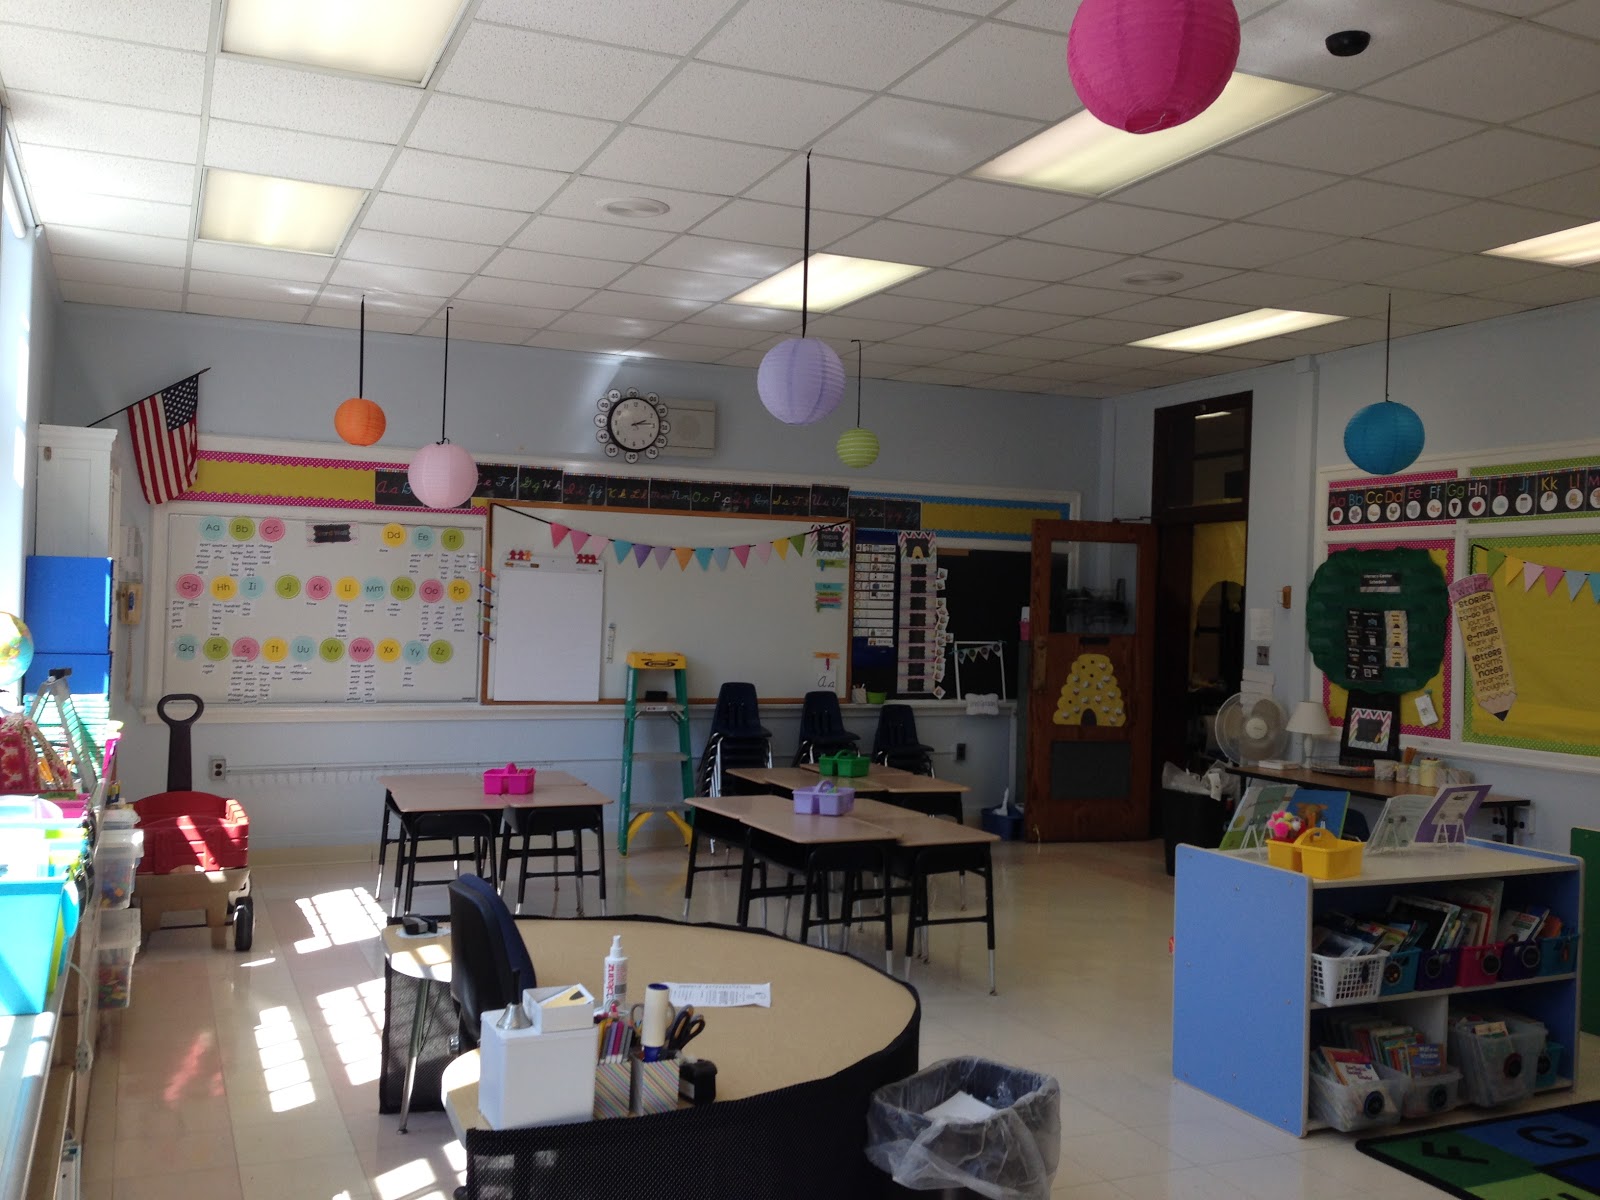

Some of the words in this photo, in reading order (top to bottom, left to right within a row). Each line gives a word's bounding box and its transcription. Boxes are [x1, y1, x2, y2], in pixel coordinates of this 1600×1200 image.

[1519, 476, 1530, 493] Jj
[1541, 476, 1559, 491] Kk
[1408, 486, 1422, 500] Ee
[1429, 485, 1442, 499] Ff
[1446, 483, 1466, 499] Gg
[1468, 482, 1488, 496] Hh
[1330, 495, 1346, 507] Aa
[1348, 494, 1364, 506] Bb
[1365, 491, 1384, 504] Cc
[1385, 490, 1404, 504] Dd
[236, 524, 249, 532] Bb
[387, 531, 401, 539] Dd
[418, 533, 430, 541] Ee
[182, 582, 198, 592] Gg
[216, 584, 230, 592] Hh
[248, 582, 257, 591] Ii
[284, 582, 292, 592] Jj
[312, 584, 324, 592] Kk
[344, 584, 352, 592] Ll
[453, 586, 464, 595] Pp
[178, 644, 195, 652] Qq
[212, 644, 223, 652] Rr
[241, 645, 251, 654] Ss
[271, 645, 280, 653] Tt
[296, 646, 310, 654] Uu
[384, 646, 394, 654] Xx
[410, 648, 421, 658] Yy
[436, 648, 445, 656] Zz
[1474, 656, 1504, 673] poems
[1478, 665, 1504, 678] notes
[1516, 1126, 1590, 1148] G
[1421, 1141, 1490, 1165] F
